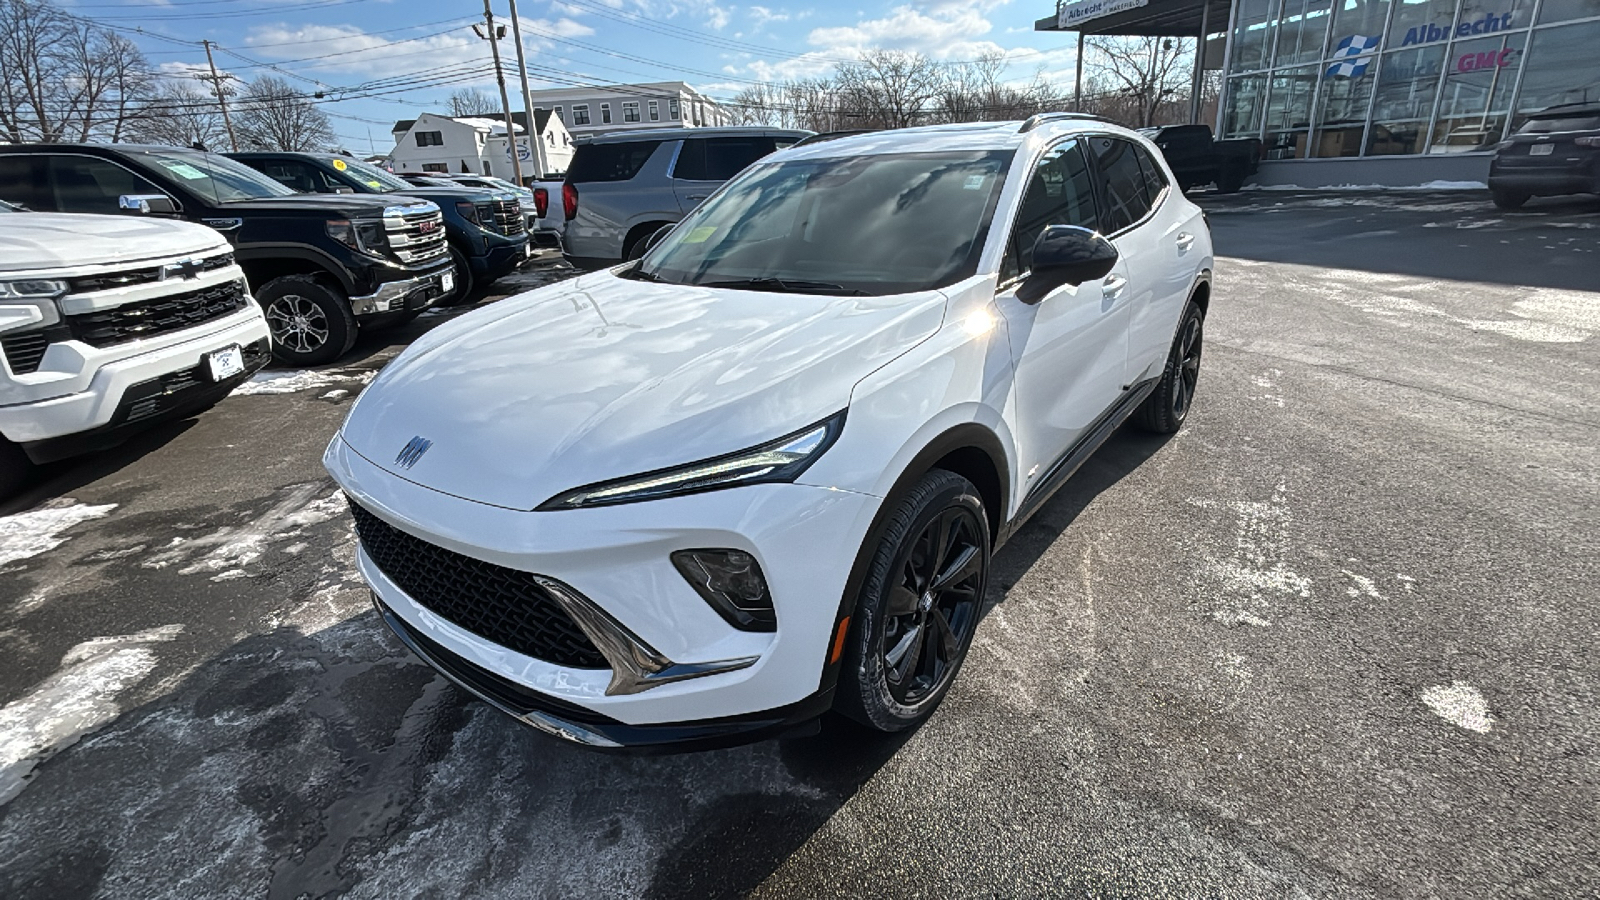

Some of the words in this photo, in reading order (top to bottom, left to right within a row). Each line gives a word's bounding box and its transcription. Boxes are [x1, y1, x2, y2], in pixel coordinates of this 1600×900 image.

[1068, 3, 1102, 19] Albrecht
[1109, 0, 1140, 13] WAKEFIELD
[1401, 12, 1511, 46] Albrecht
[1457, 48, 1514, 72] GMC
